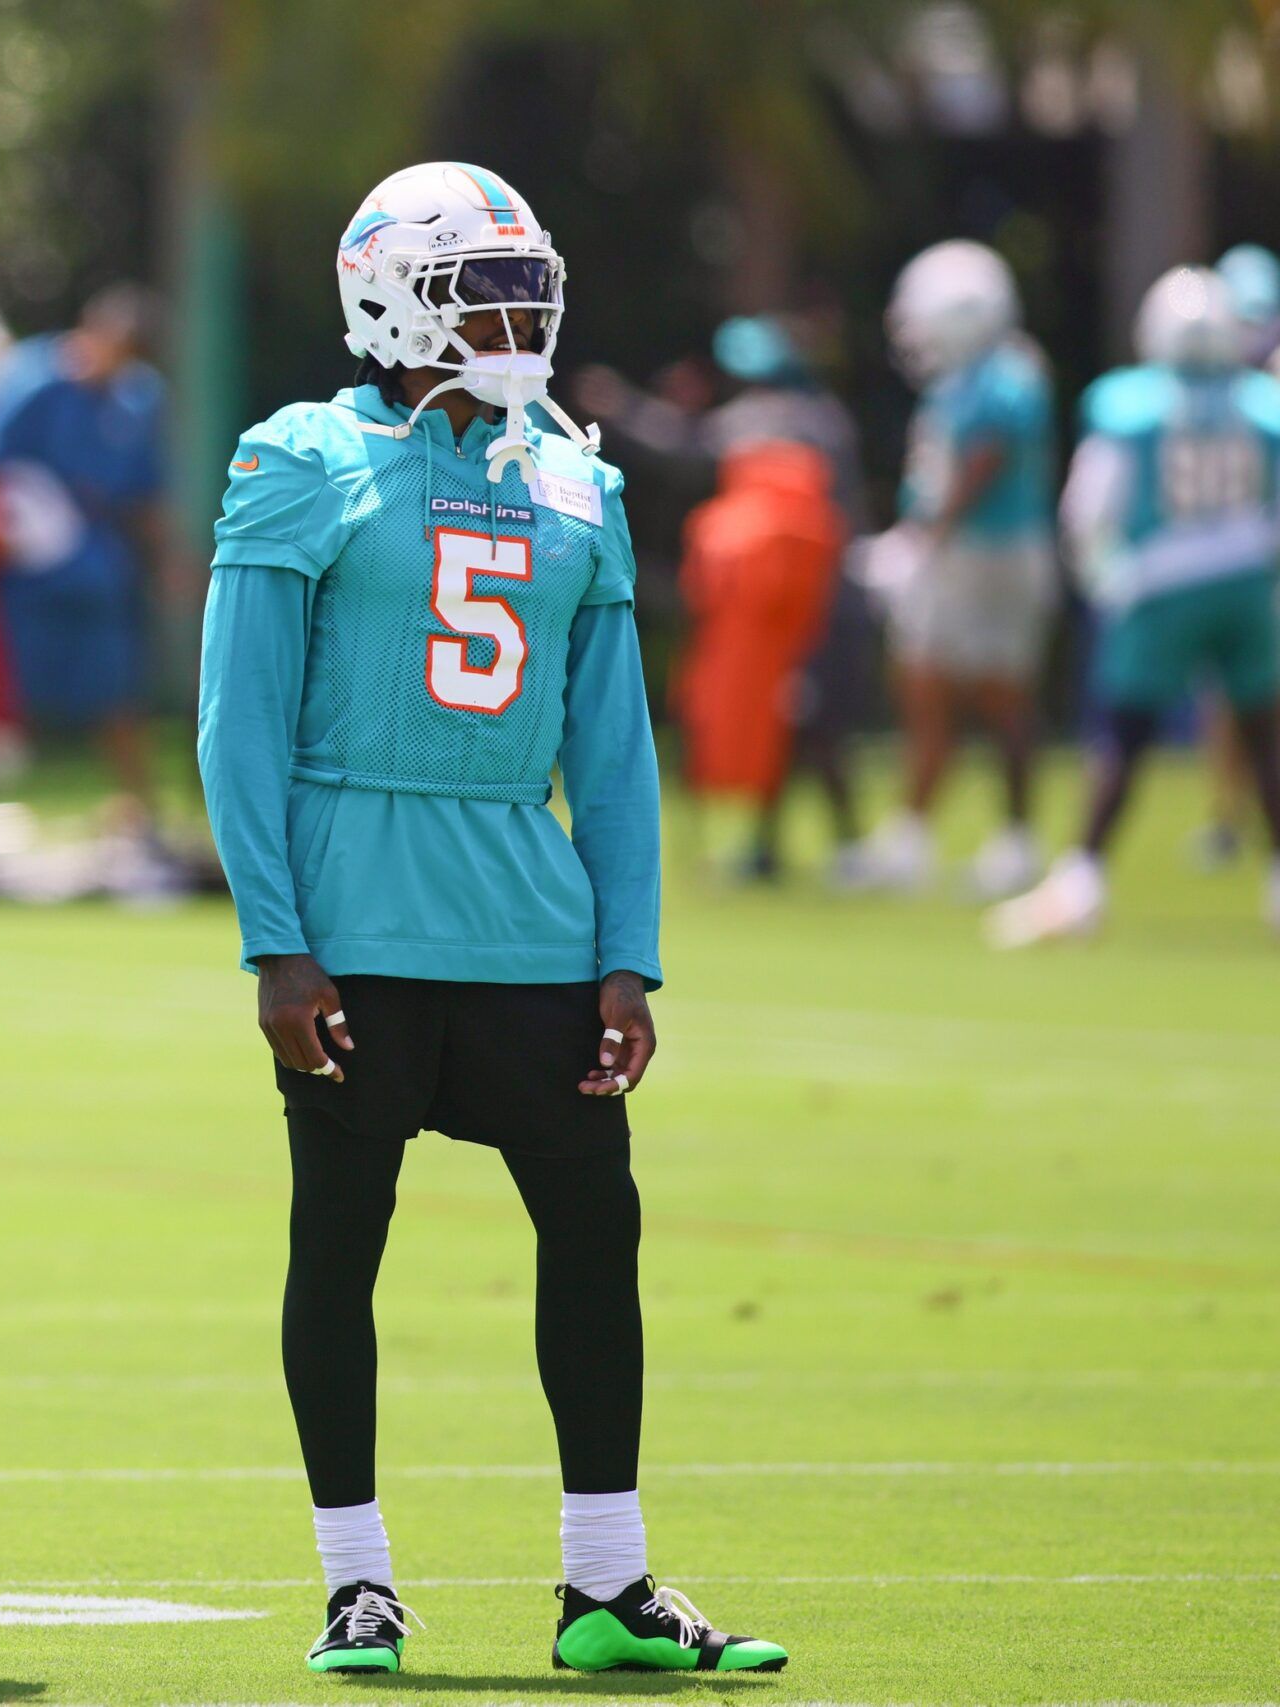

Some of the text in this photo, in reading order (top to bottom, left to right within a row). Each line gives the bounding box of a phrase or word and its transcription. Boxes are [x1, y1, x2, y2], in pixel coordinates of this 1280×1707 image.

[431, 239, 463, 249] OAKLEY
[559, 486, 591, 502] Baptist
[431, 498, 531, 520] Dolphins
[425, 526, 532, 716] 5
